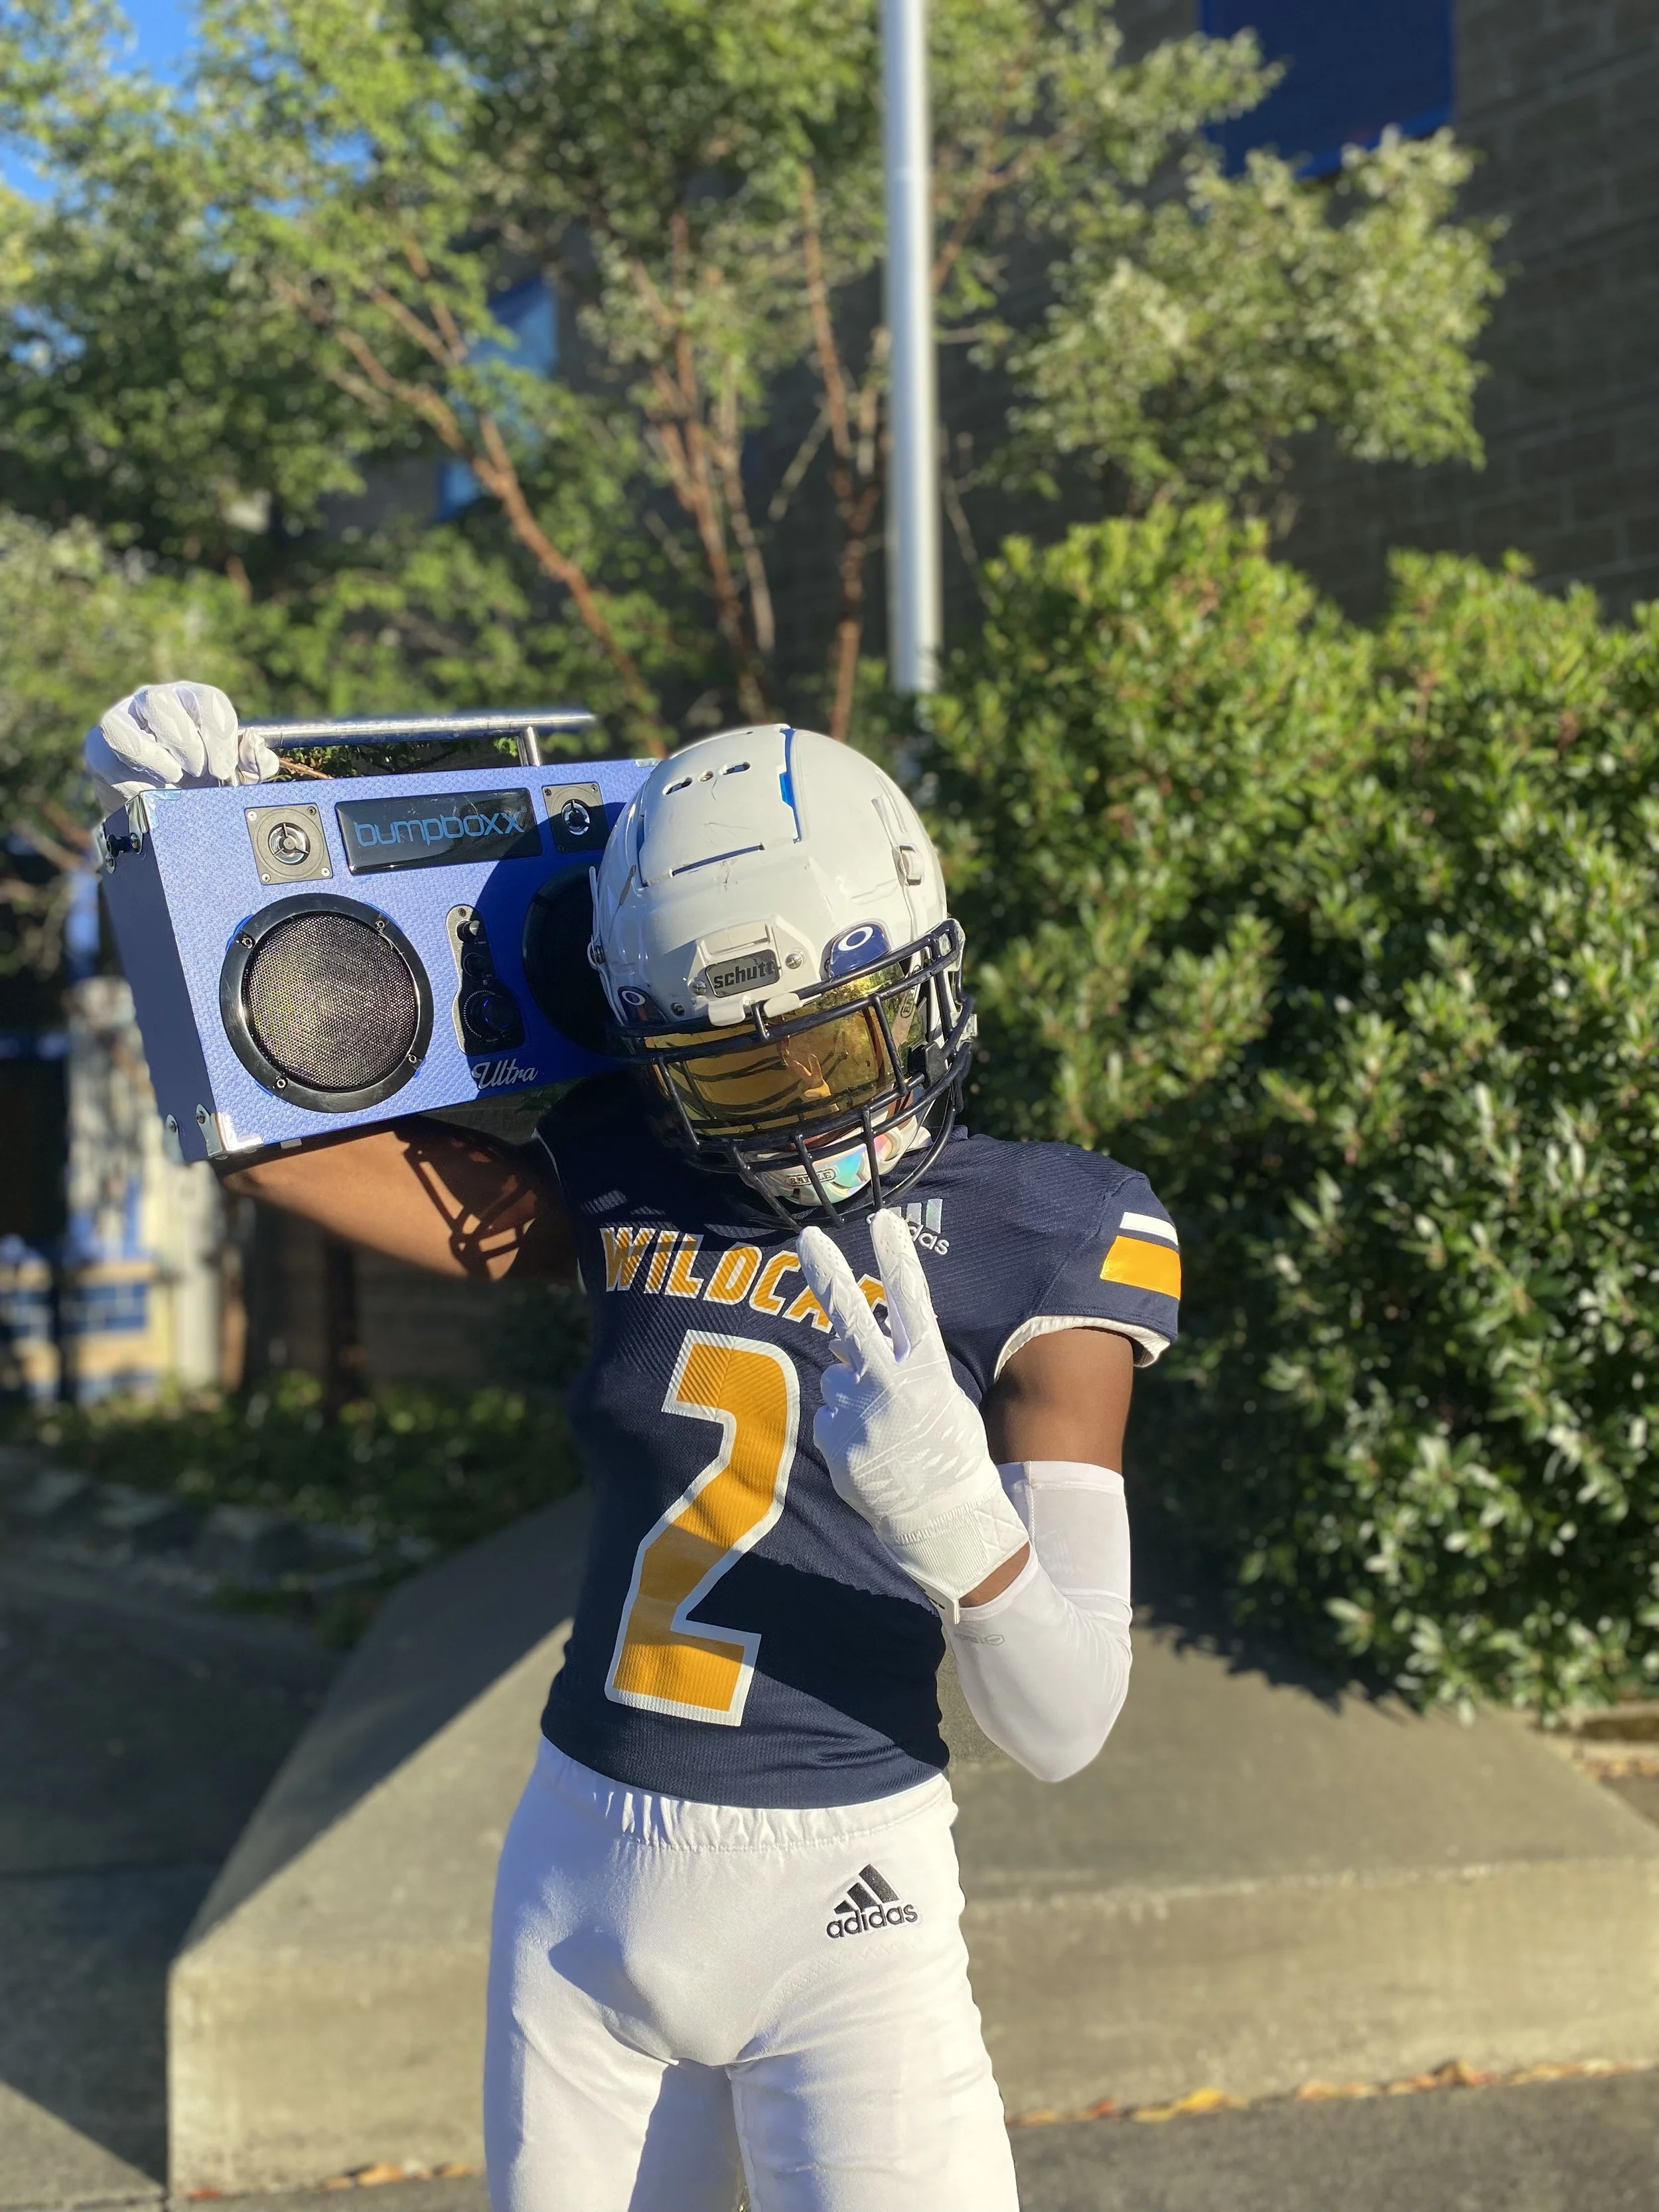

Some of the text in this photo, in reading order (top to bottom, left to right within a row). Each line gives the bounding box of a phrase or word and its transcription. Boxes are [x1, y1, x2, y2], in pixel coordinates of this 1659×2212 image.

[354, 810, 525, 846] bumpboxx
[713, 958, 775, 989] schutt
[471, 1058, 538, 1090] Ultra
[600, 1226, 891, 1335] WILDCA
[605, 1329, 800, 1727] 2
[826, 1903, 918, 1939] adidas
